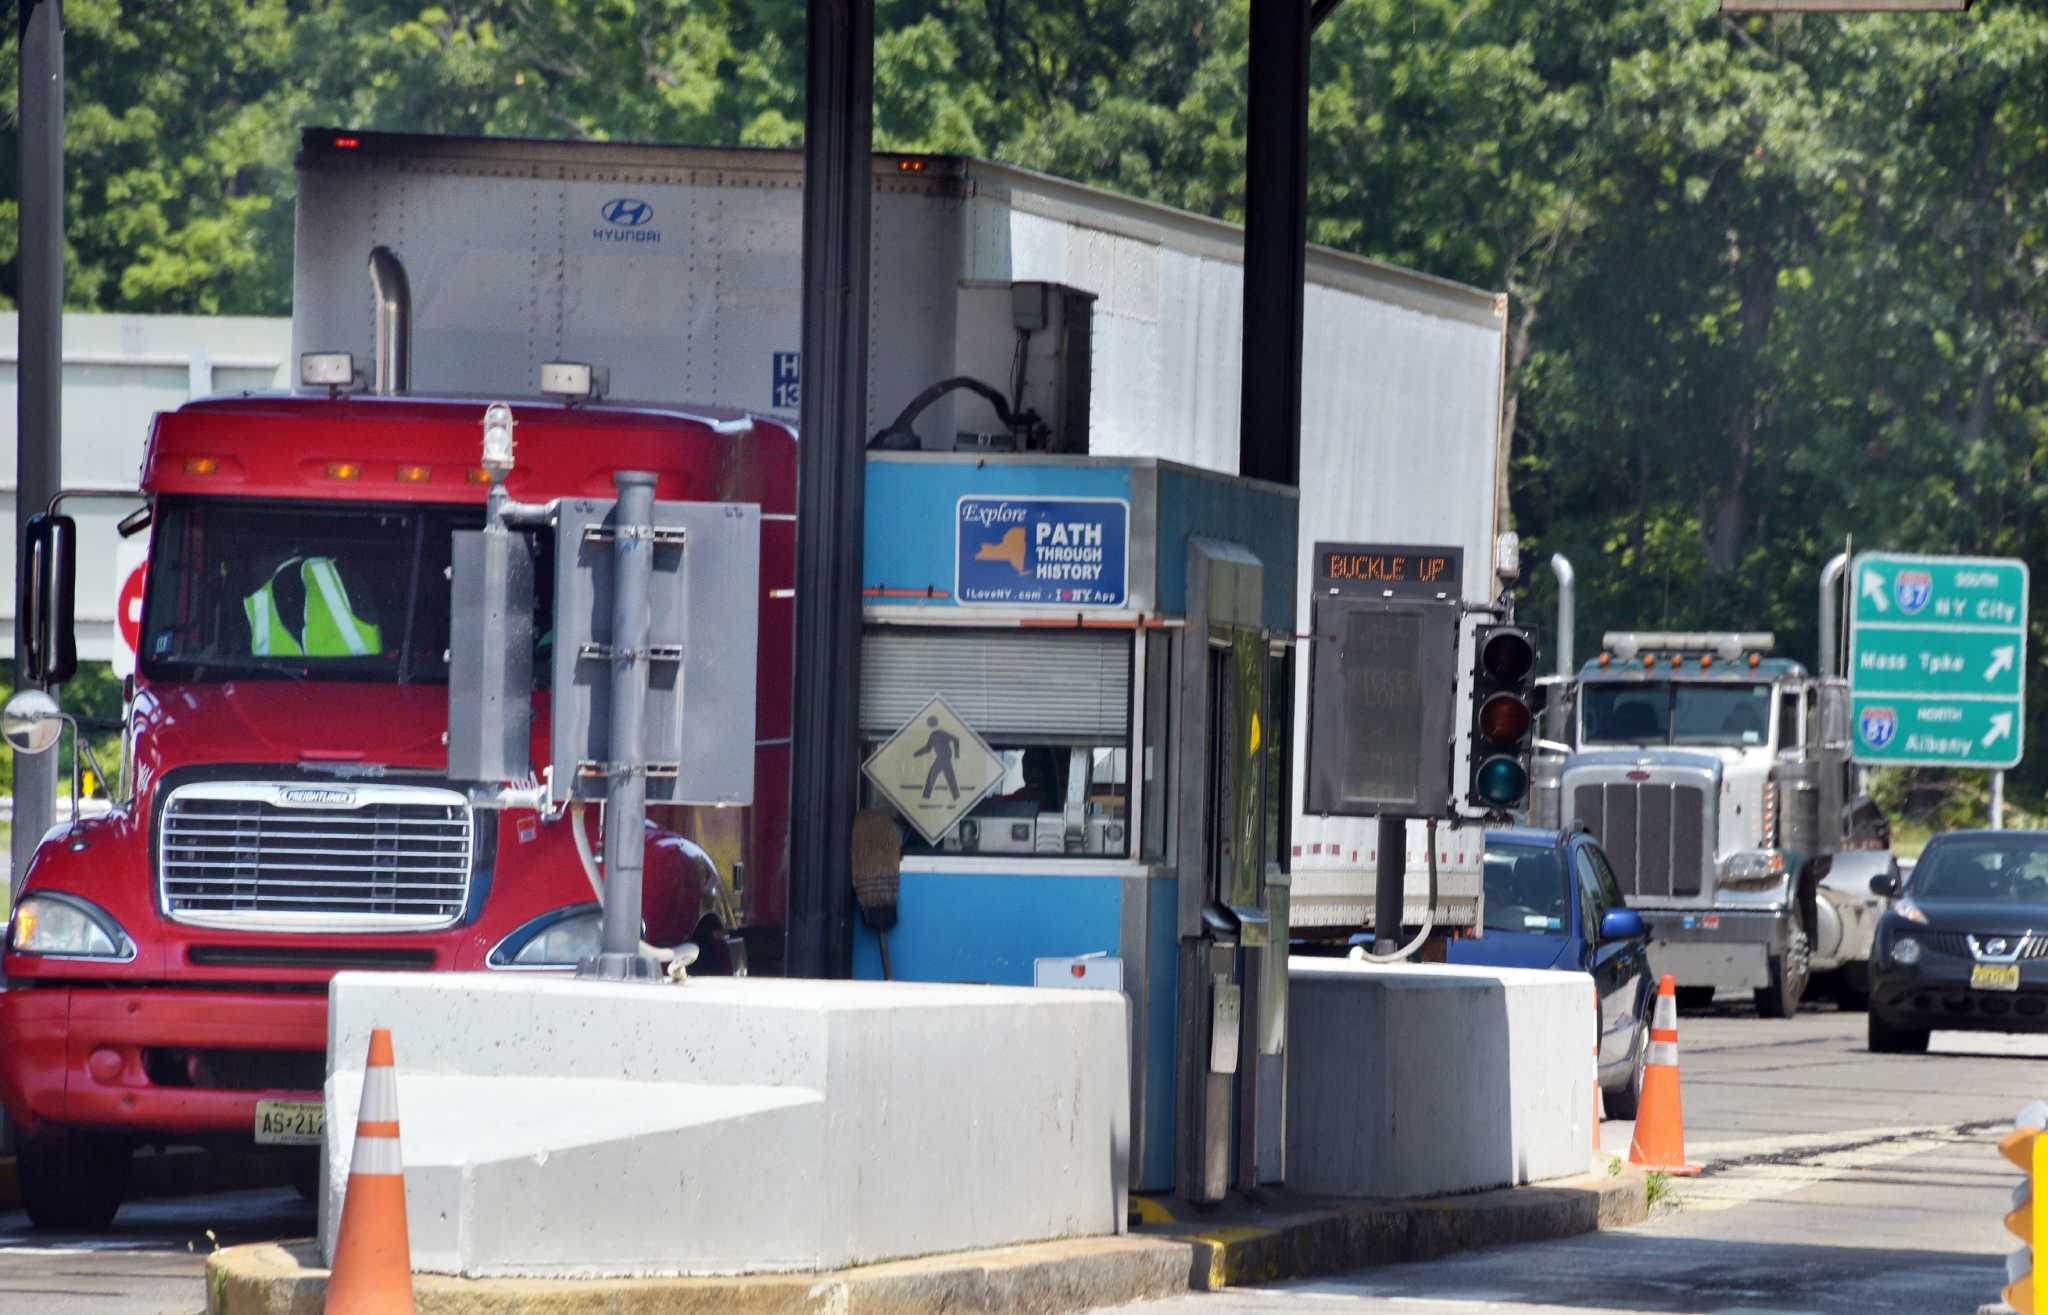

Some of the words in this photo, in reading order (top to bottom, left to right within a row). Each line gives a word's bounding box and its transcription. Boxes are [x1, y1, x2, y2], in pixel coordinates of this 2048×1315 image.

[592, 228, 661, 243] HYUNDAI
[962, 502, 1027, 528] Explore
[1036, 522, 1102, 546] PATH
[1036, 546, 1102, 562] THROUGH
[1036, 563, 1103, 580] HISTORY
[1330, 553, 1406, 582] BUCKLE
[1418, 556, 1447, 582] UP
[1954, 571, 1999, 588] SOUTH
[1094, 589, 1116, 603] App
[1935, 598, 1967, 616] NY
[1976, 600, 2016, 623] City
[1860, 651, 1907, 670] Mass
[1919, 652, 1965, 674] Tpke
[1917, 706, 1963, 722] NORTH
[1904, 733, 1973, 758] Albany
